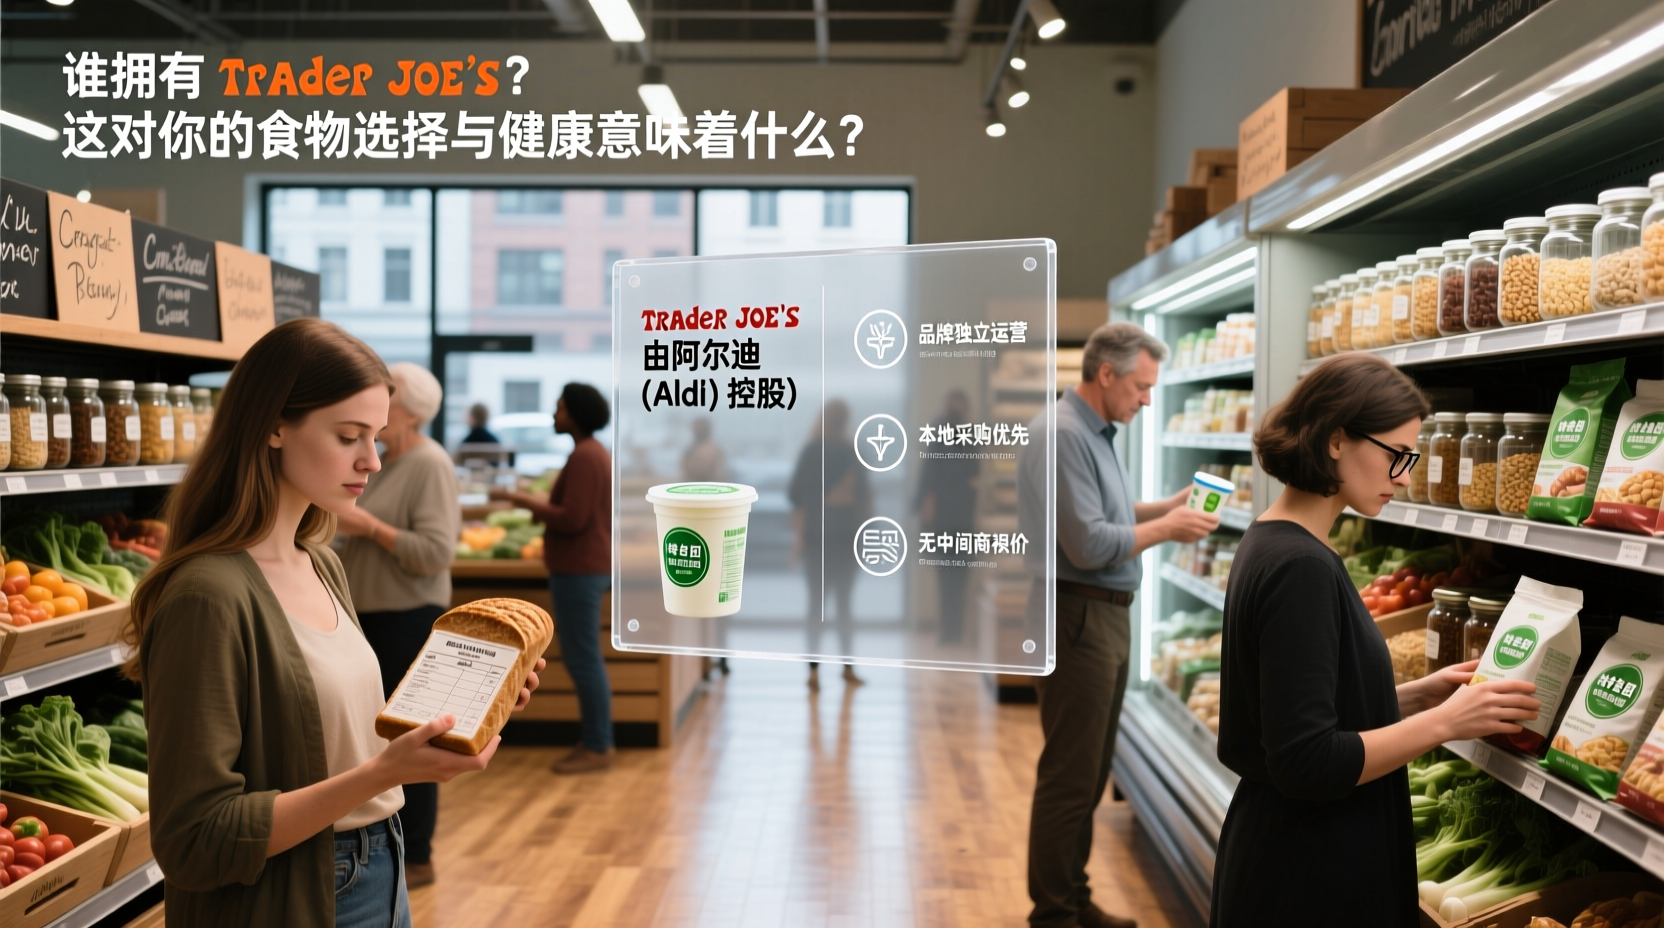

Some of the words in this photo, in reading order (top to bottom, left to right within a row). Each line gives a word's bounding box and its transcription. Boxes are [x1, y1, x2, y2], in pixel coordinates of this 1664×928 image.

[735, 304, 800, 329] JOE'S
[918, 320, 1028, 345] 品牌独立运营
[644, 338, 761, 372] 由阿尔迪
[642, 378, 719, 412] (Aldi)
[727, 376, 797, 411] 控股)
[918, 422, 1030, 446] 本地采购优先
